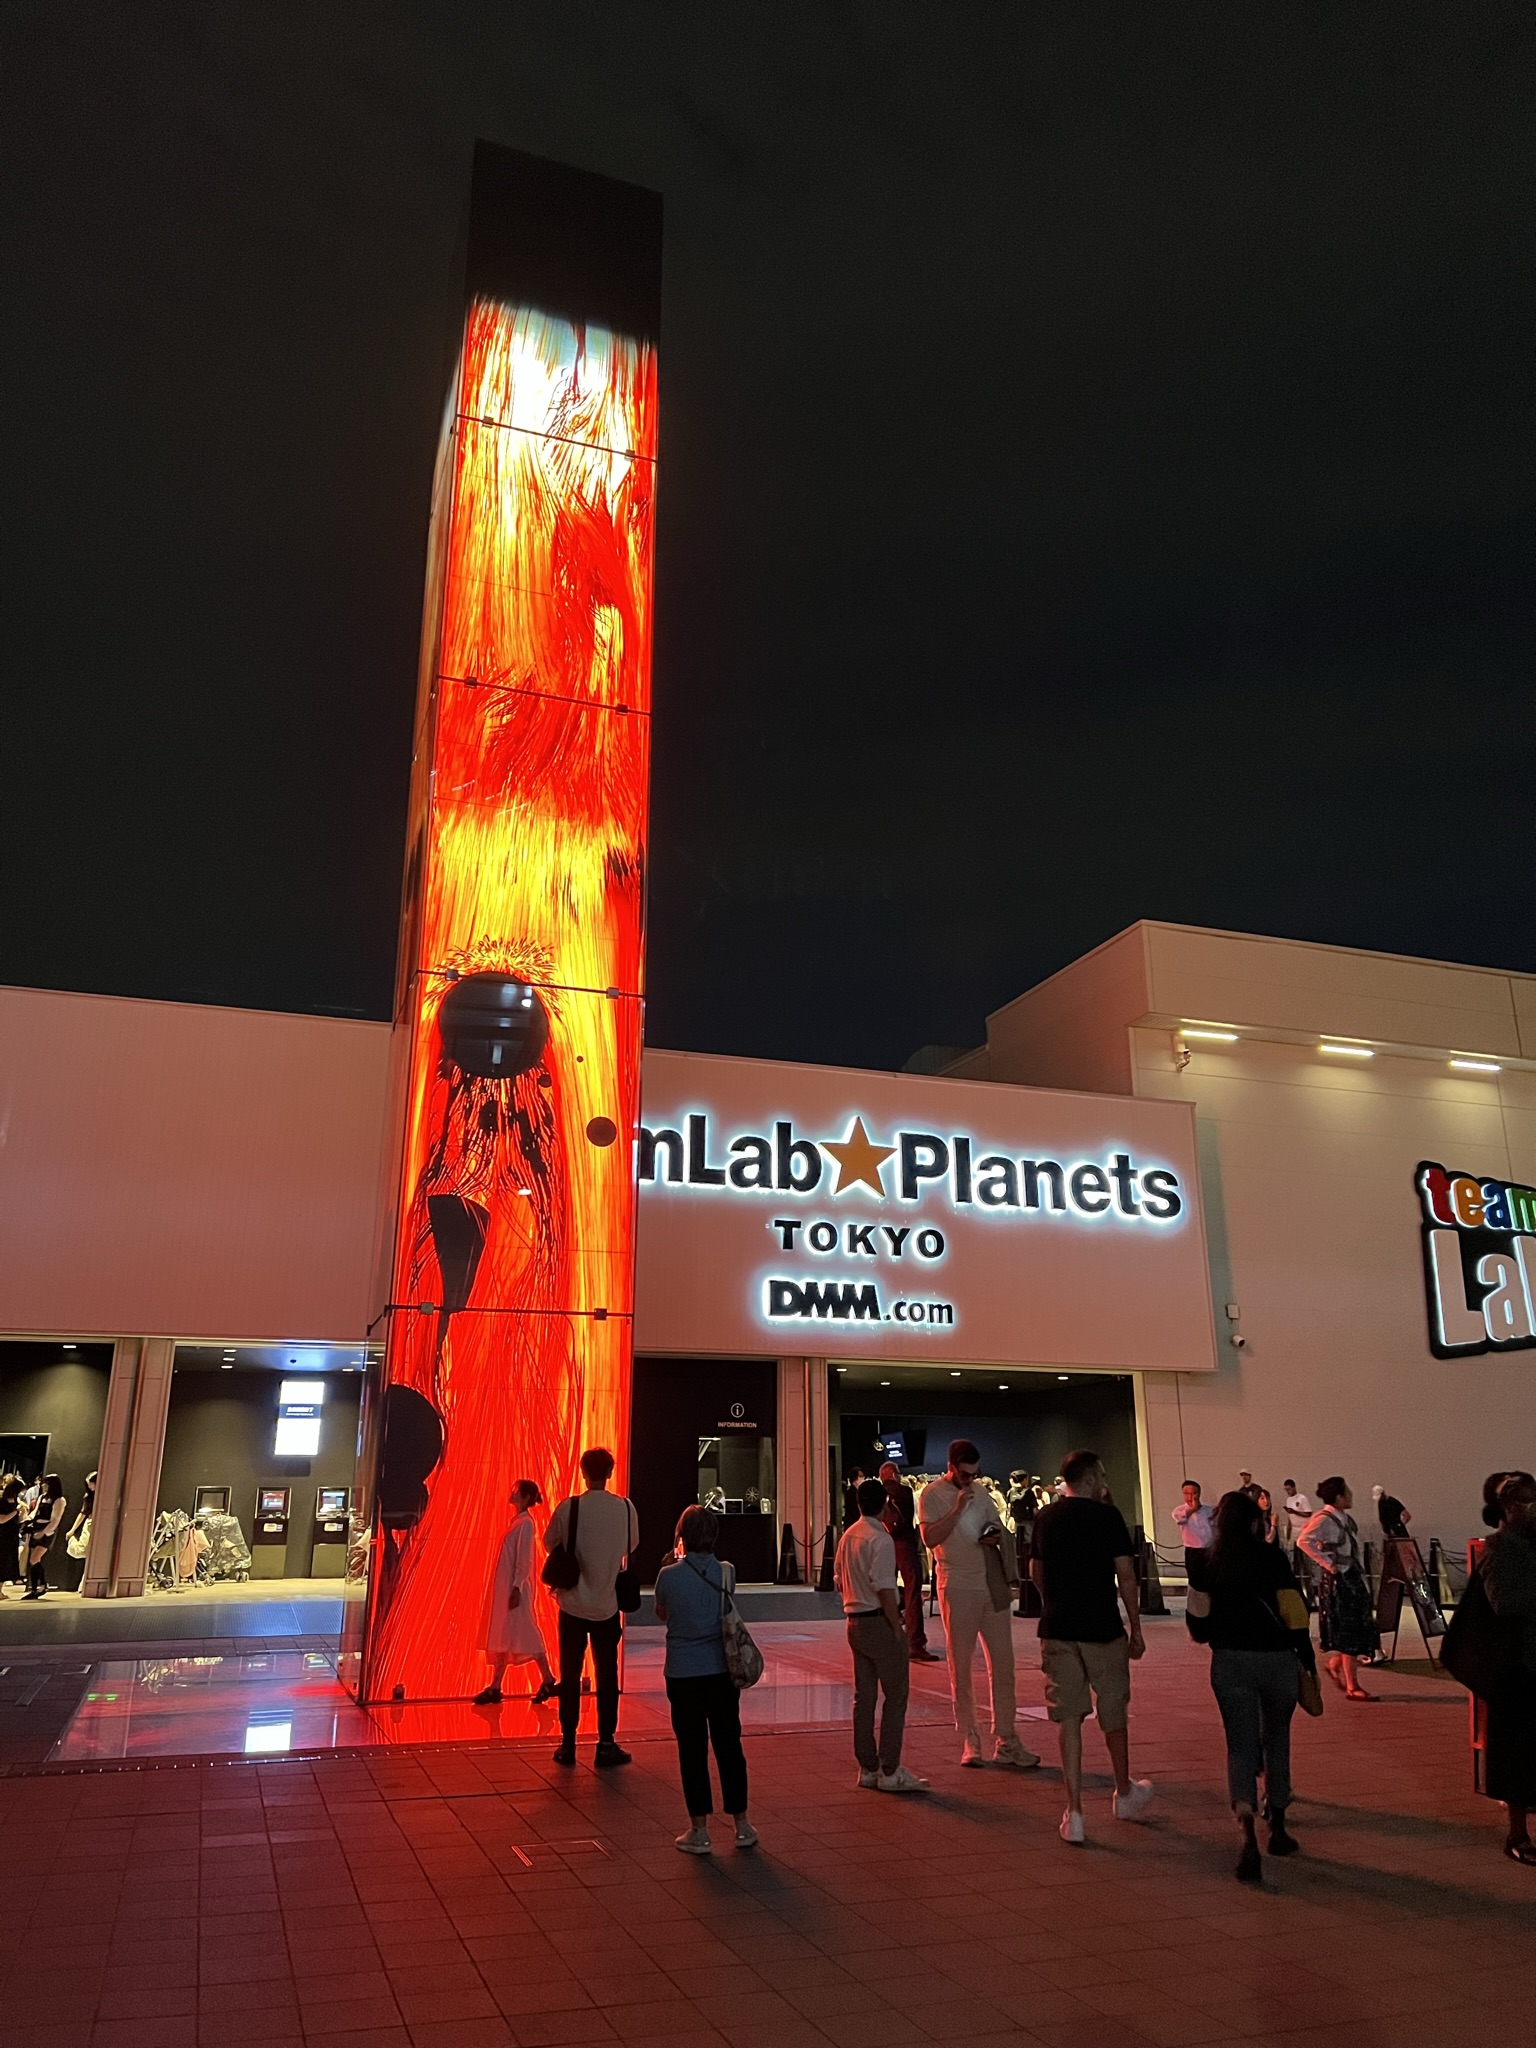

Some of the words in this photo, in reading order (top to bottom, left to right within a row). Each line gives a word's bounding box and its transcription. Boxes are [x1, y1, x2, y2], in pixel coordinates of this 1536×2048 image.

[899, 1132, 1182, 1218] Planets
[774, 1220, 945, 1258] TOKYO
[768, 1280, 954, 1324] DMM.com
